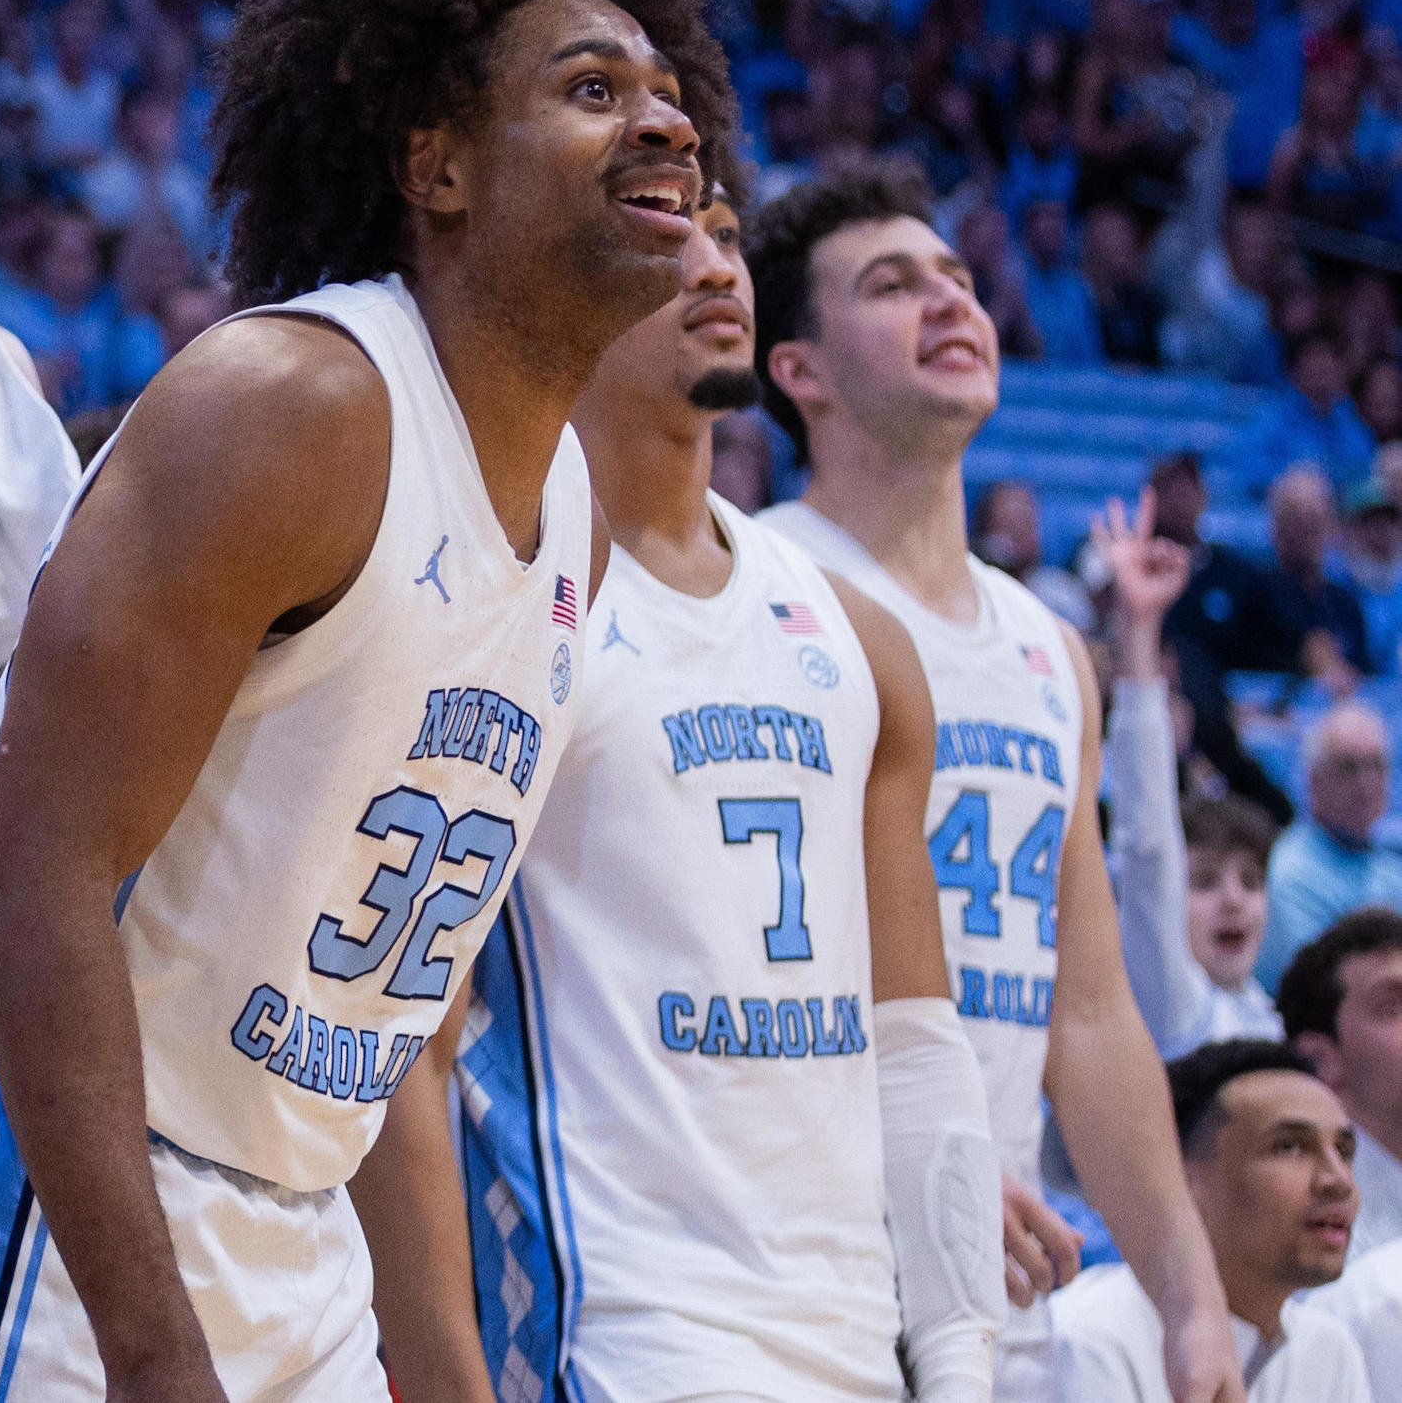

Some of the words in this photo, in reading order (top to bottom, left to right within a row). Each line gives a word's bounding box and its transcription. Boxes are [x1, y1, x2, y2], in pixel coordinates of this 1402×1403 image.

[406, 687, 542, 798] NORTH
[662, 703, 834, 775] NORTH
[306, 784, 518, 1001] 32
[718, 796, 813, 964] 7
[928, 788, 1065, 948] 44
